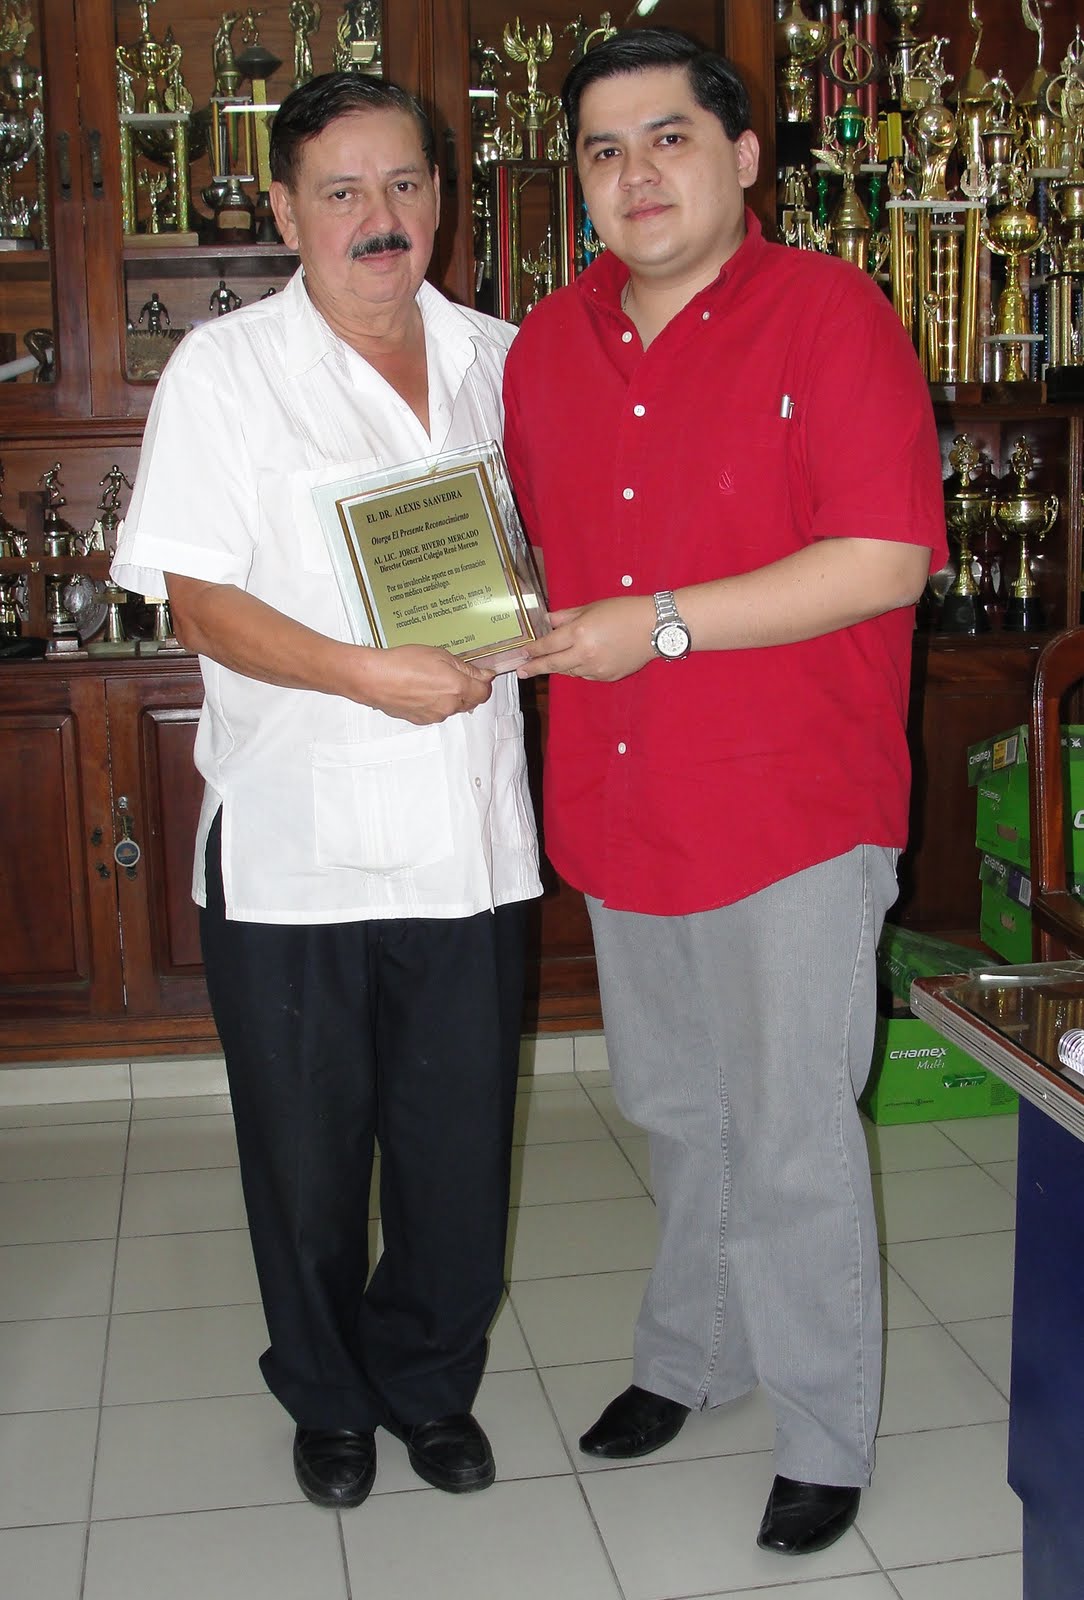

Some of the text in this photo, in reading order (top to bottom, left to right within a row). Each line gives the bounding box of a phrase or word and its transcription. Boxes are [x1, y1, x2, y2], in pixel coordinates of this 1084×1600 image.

[366, 490, 462, 524] EL DR. ALEXIS SAAVEDRA
[372, 512, 470, 544] Otorga El Presente Reconocimiento
[374, 528, 479, 566] AL LIC. JORGE RIVERO MERCADO
[380, 540, 478, 573] Director General Colegio René Moreno
[387, 584, 396, 592] Por
[404, 574, 430, 588] invalorable
[432, 570, 446, 581] aporte
[460, 560, 486, 572] formación
[390, 594, 404, 602] como
[404, 588, 422, 598] médico
[404, 604, 428, 616] confieres
[438, 594, 466, 606] beneficio,
[468, 588, 484, 598] nunca
[396, 616, 422, 628] recuerdes,
[452, 603, 468, 612] nunca
[450, 638, 464, 646] Marzo
[464, 634, 476, 642] 2010
[916, 1060, 945, 1070] Multi
